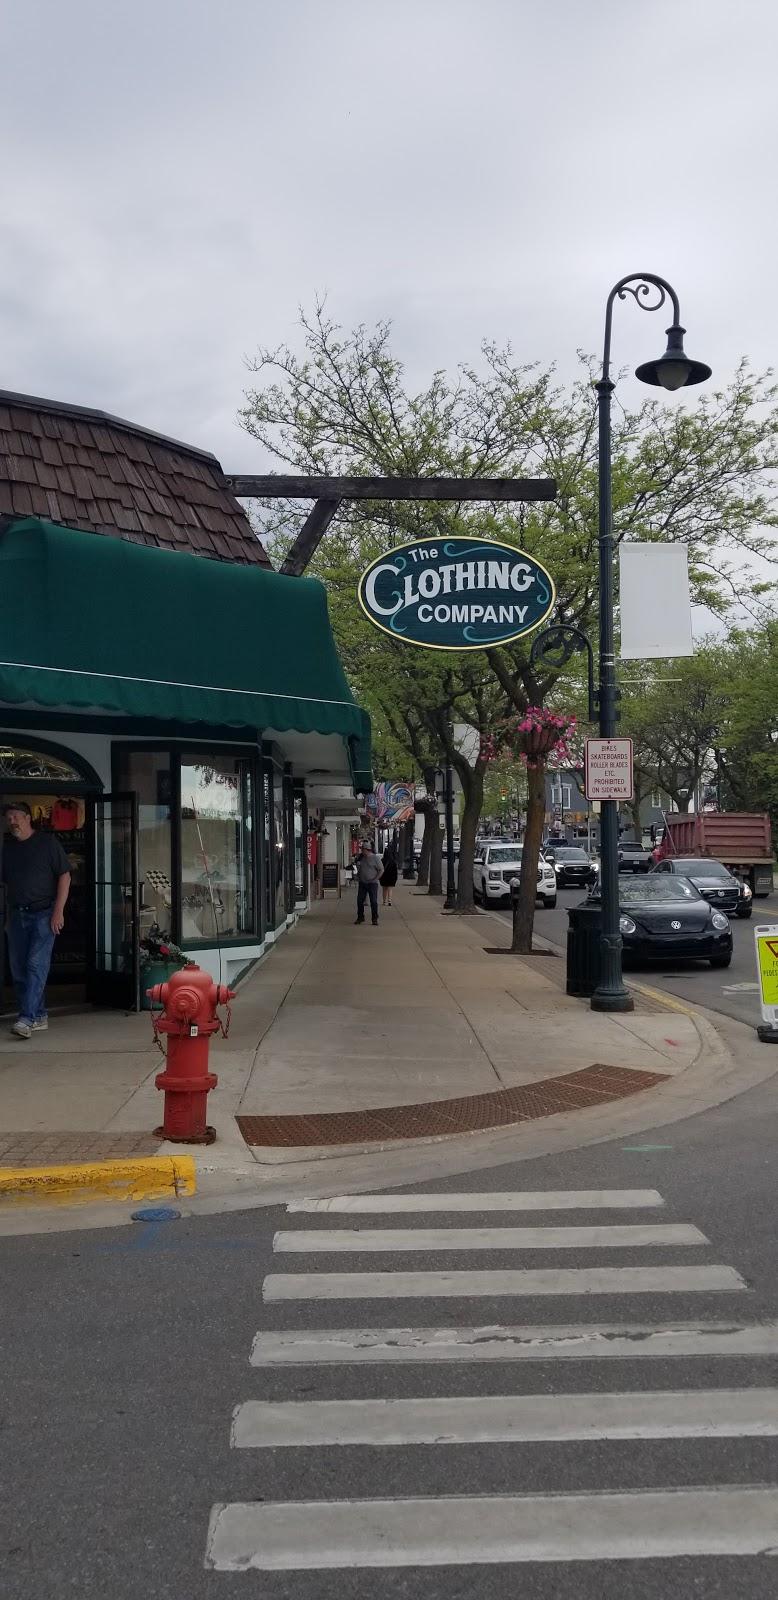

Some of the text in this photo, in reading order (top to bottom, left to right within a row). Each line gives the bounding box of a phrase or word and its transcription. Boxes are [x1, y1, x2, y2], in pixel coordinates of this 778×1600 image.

[408, 548, 439, 562] The
[365, 561, 536, 615] CLOTHING
[417, 604, 529, 624] COMPANY
